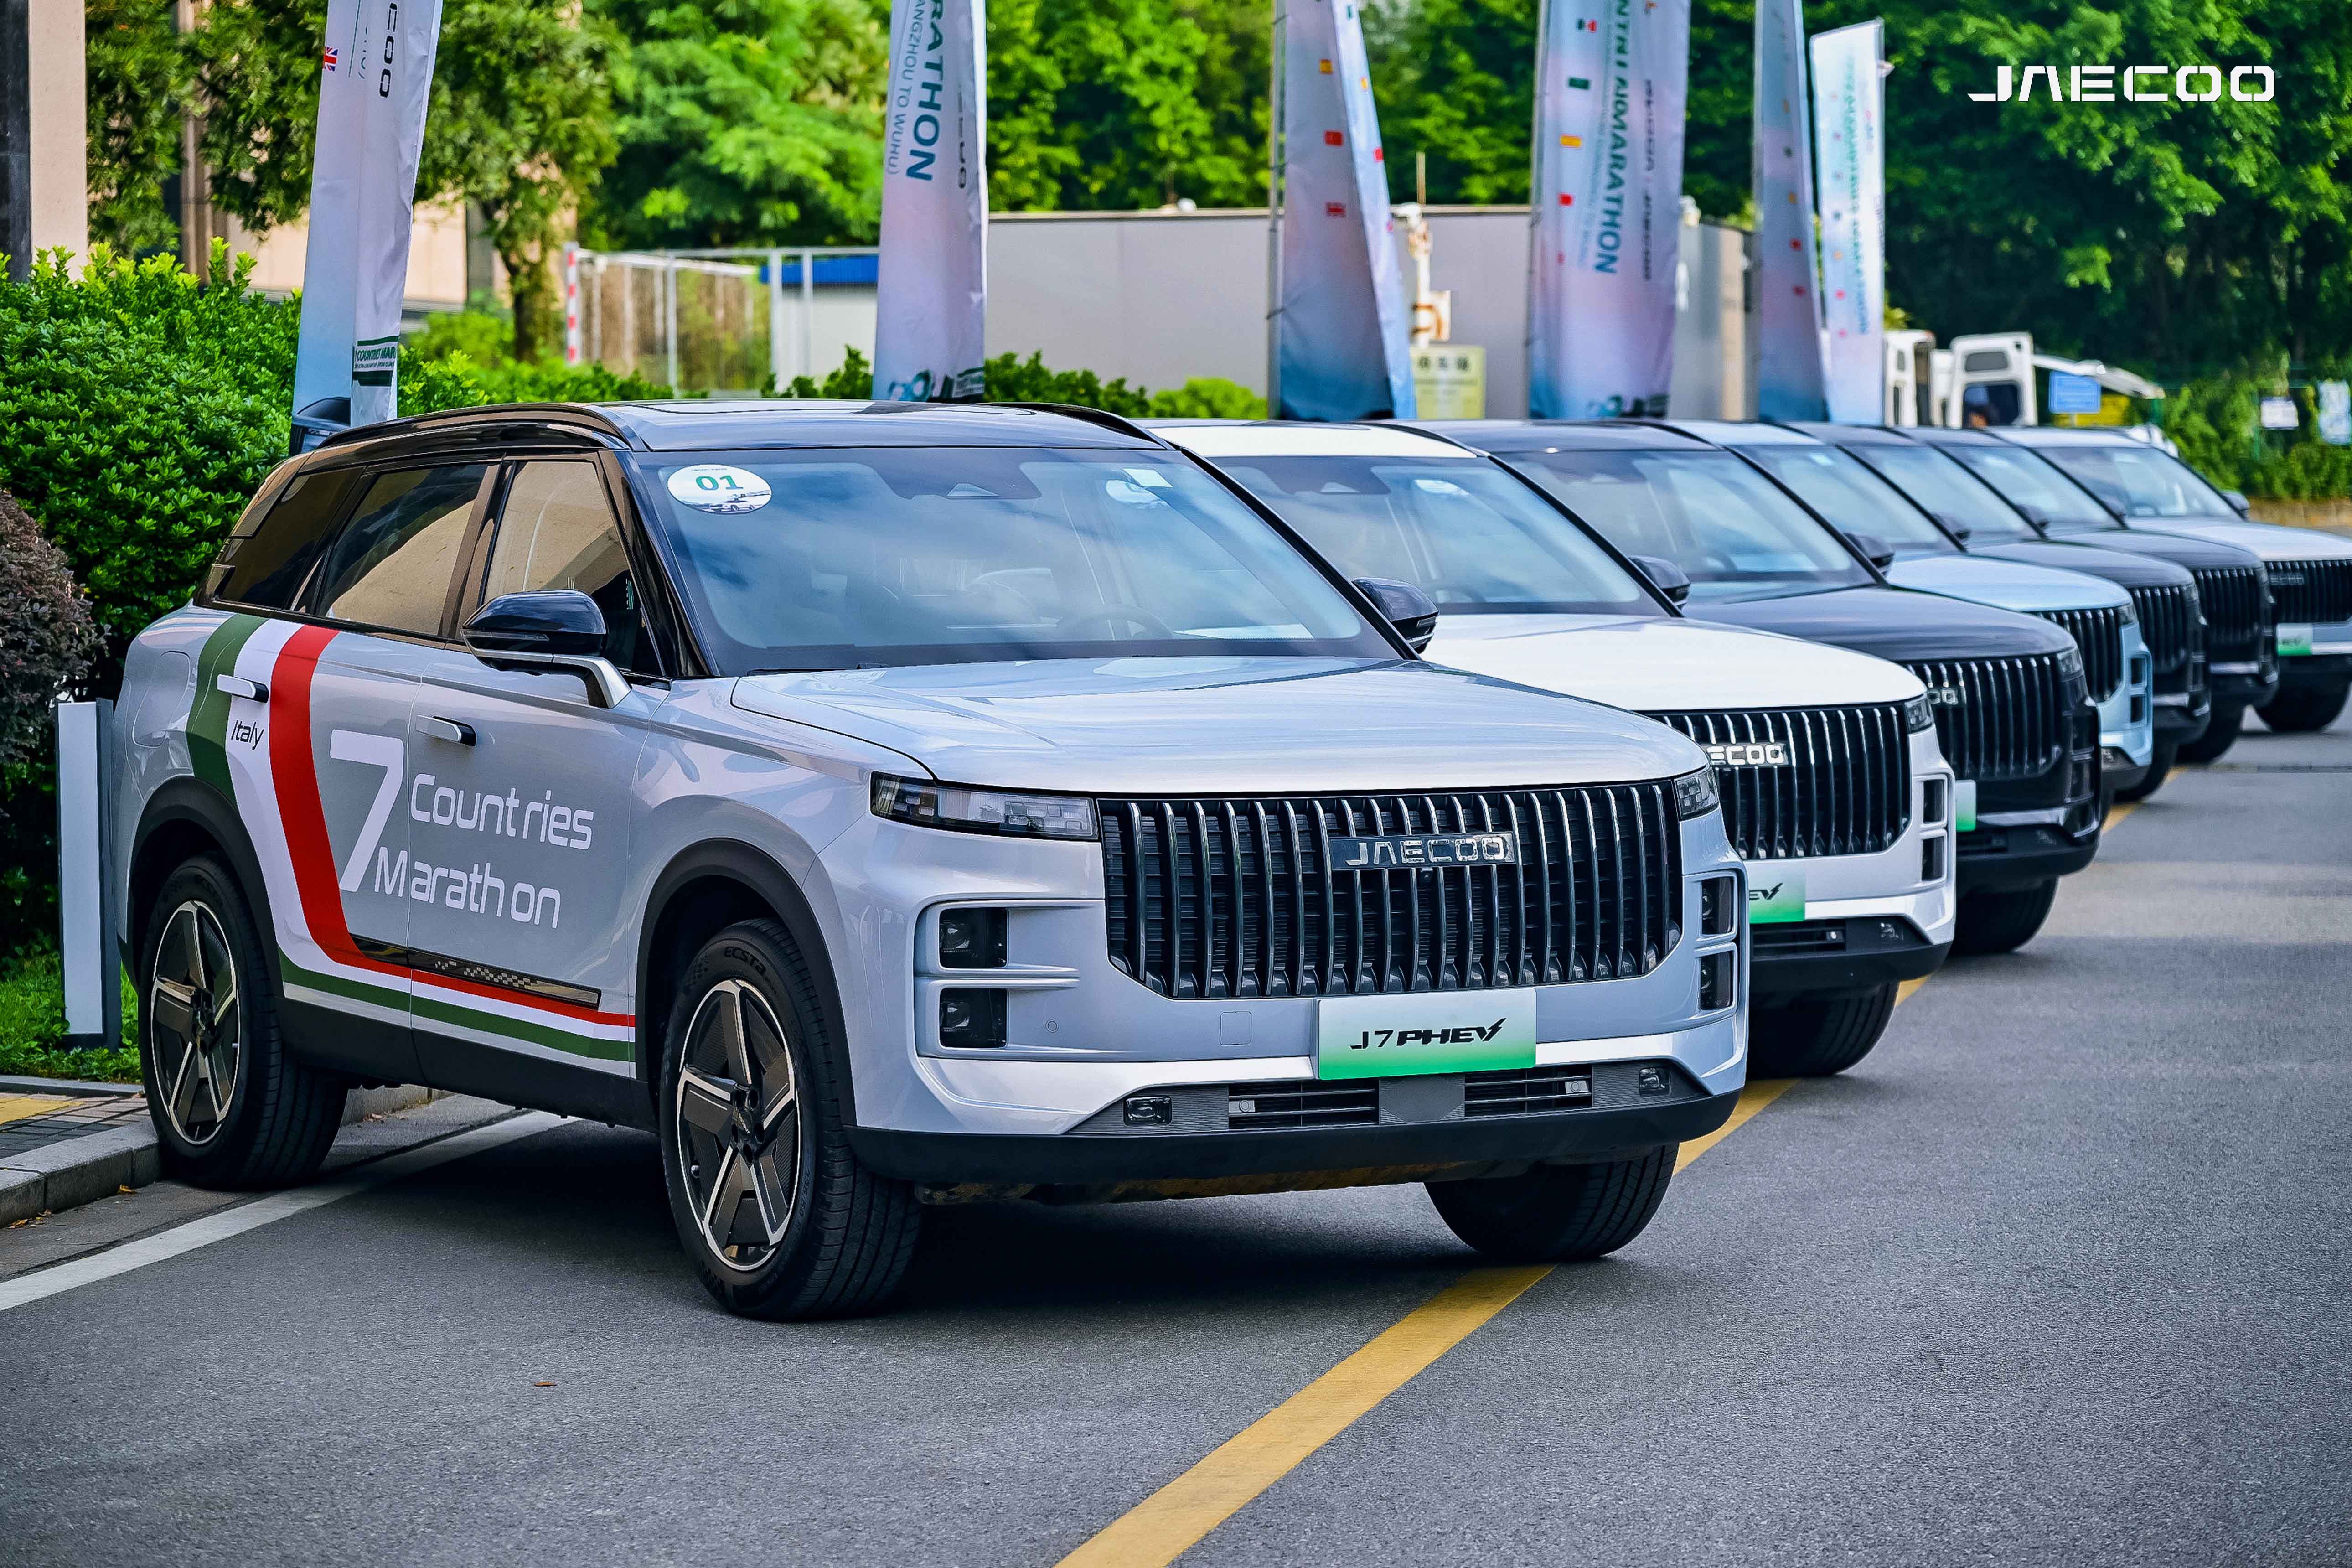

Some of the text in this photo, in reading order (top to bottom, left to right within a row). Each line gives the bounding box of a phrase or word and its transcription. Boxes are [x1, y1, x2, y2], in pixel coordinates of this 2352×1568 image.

[897, 87, 911, 108] TO
[906, 0, 944, 181] RATHON
[696, 475, 744, 491] 01
[231, 720, 265, 750] Italy
[330, 729, 594, 892] 7 Countries
[1345, 837, 1505, 865] JAECOO
[374, 846, 561, 929] Marathon
